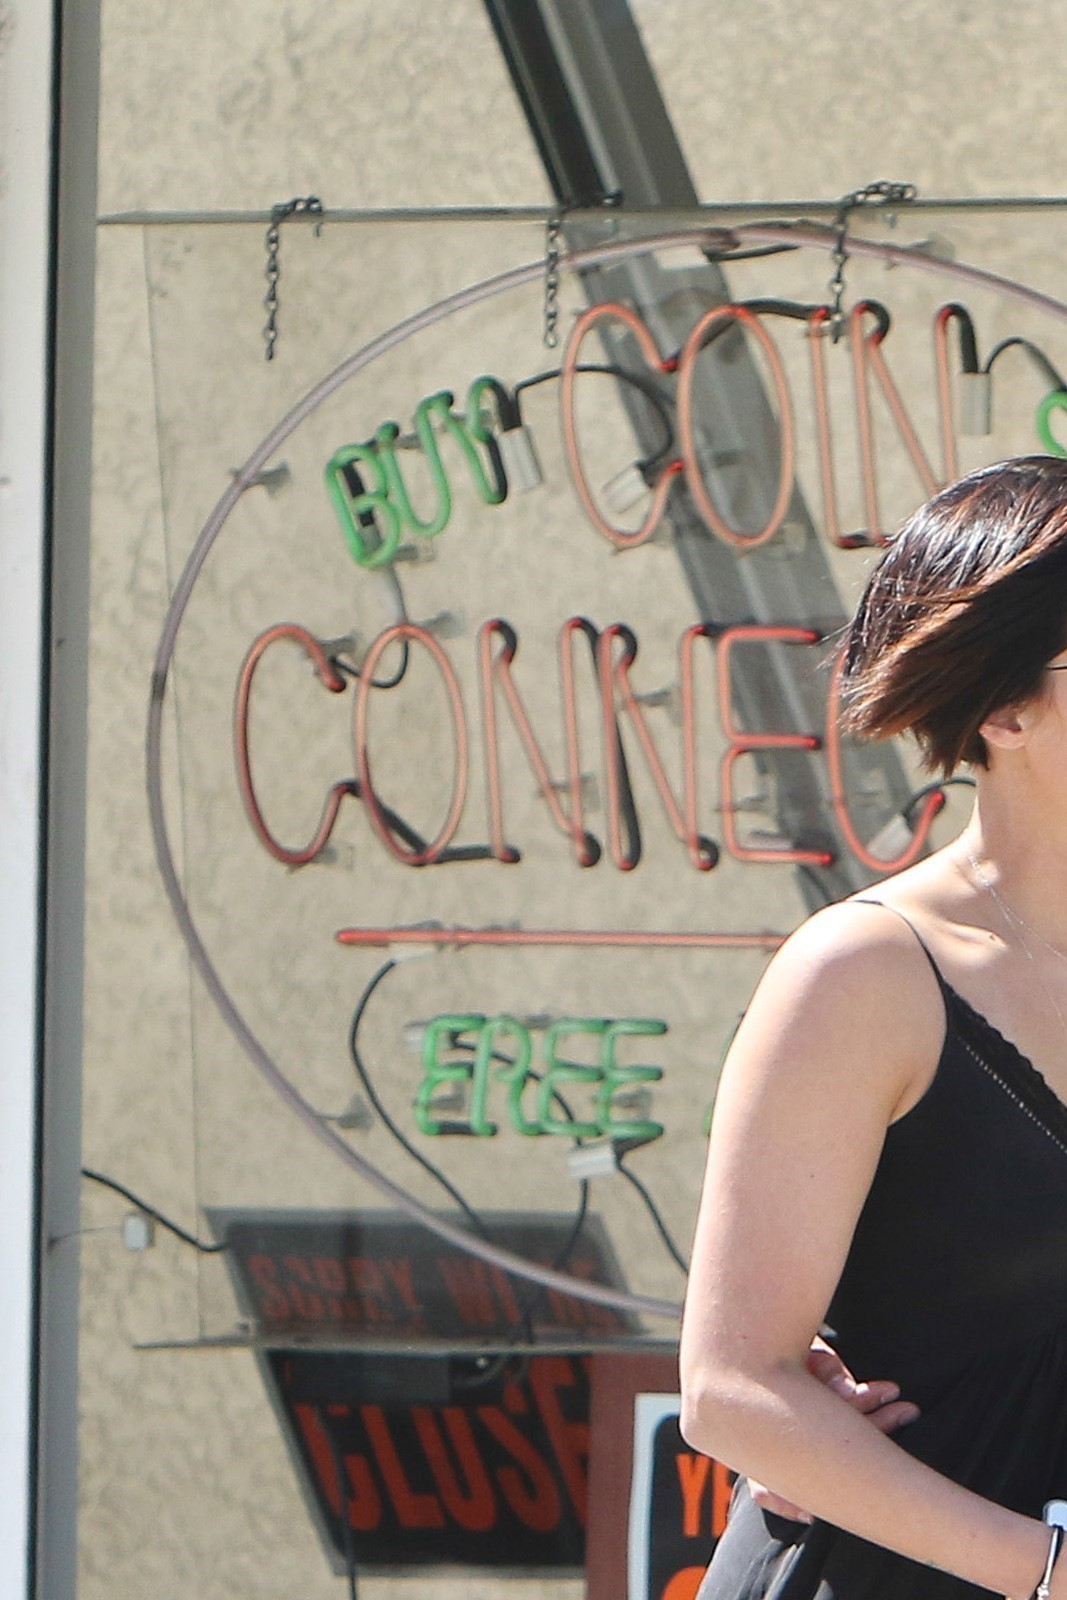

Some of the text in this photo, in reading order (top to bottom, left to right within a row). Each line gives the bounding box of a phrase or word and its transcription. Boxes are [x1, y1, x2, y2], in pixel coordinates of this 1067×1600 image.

[325, 375, 508, 568] BUY
[562, 300, 974, 551] COIN
[414, 1013, 669, 1138] FREE
[283, 1353, 594, 1532] CLOSE
